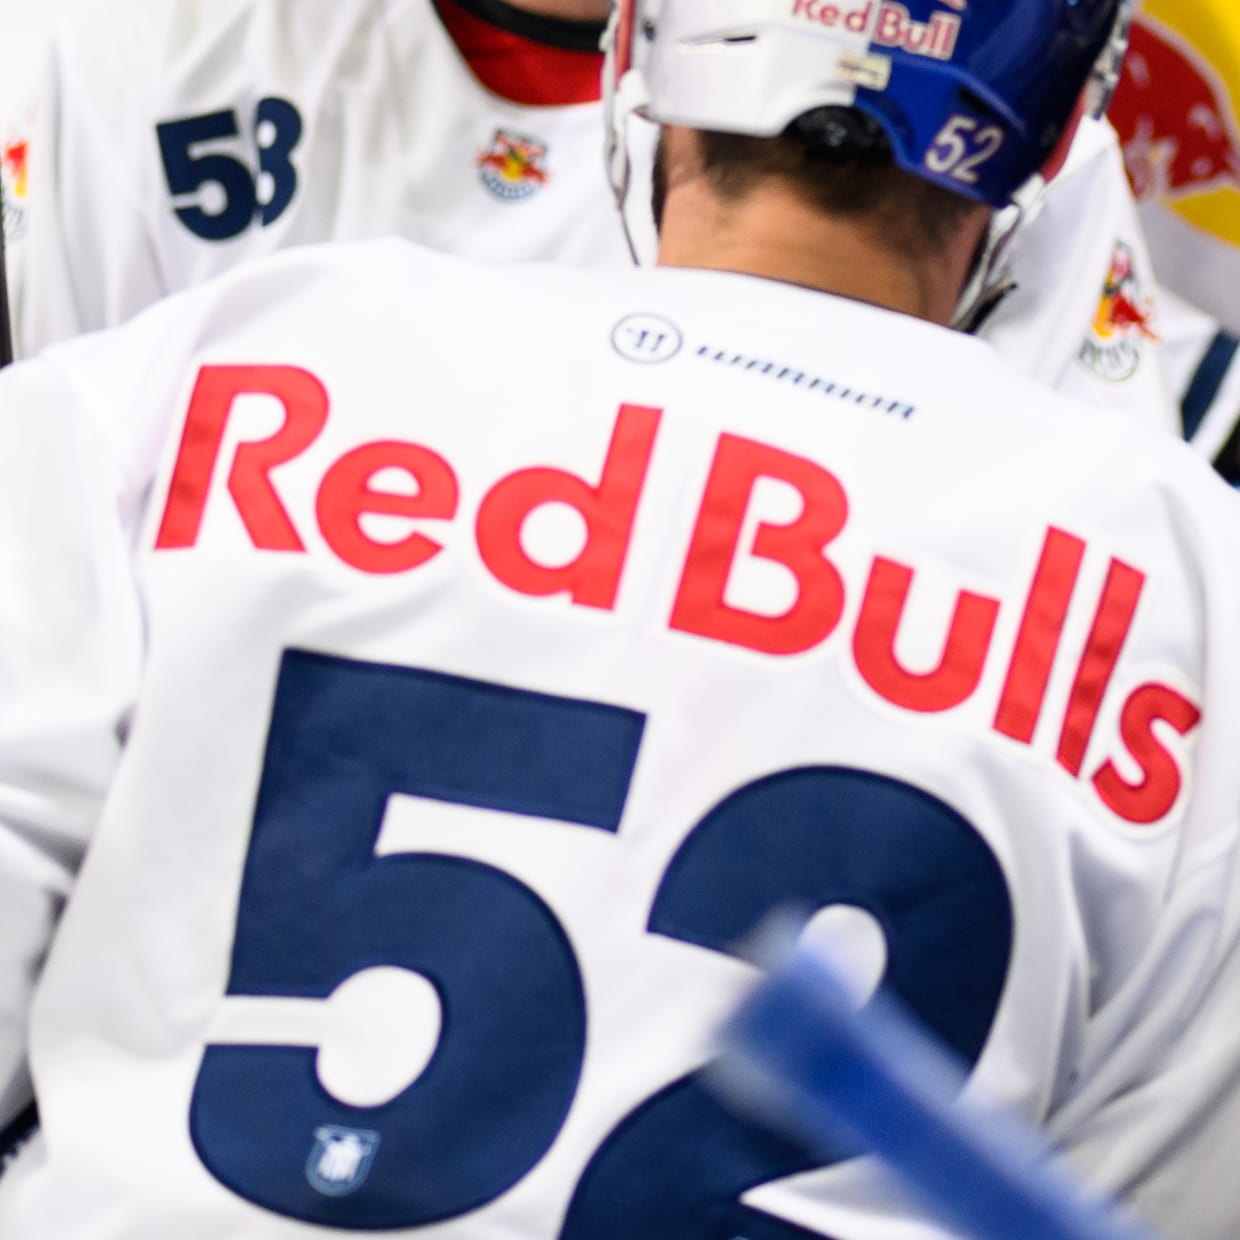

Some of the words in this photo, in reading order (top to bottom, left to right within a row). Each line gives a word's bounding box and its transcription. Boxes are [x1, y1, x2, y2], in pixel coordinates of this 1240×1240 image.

[875, 3, 958, 58] Bull
[923, 114, 1005, 184] 52
[153, 363, 664, 613] Red
[667, 431, 1203, 827] Bulls
[187, 647, 1015, 1240] 52
